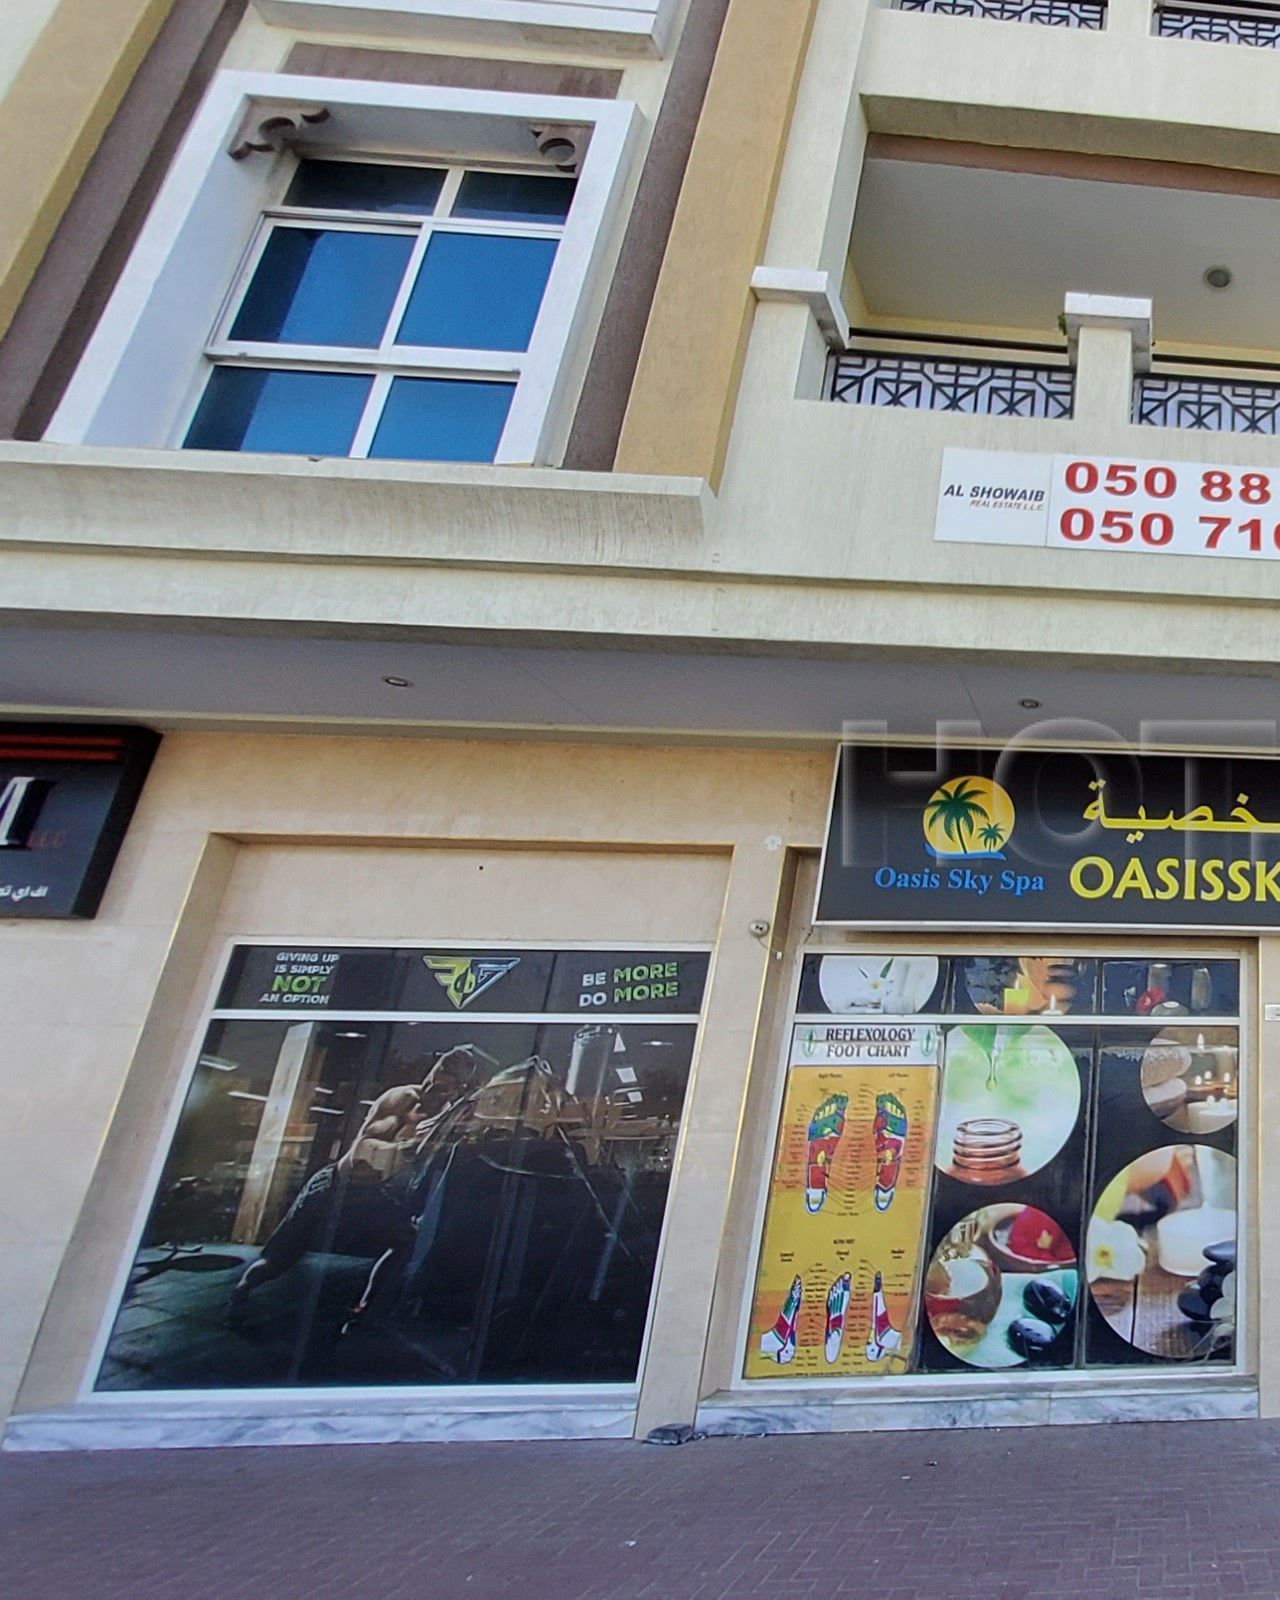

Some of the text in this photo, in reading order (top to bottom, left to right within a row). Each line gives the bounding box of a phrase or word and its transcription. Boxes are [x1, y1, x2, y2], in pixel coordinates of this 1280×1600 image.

[1064, 460, 1178, 499] 050
[943, 484, 1045, 502] AL SHOWAIB
[970, 500, 990, 508] REAL
[993, 501, 1021, 510] ESTATE
[1059, 507, 1174, 546] 050
[875, 867, 1044, 896] Oasis Sky Spa
[276, 952, 340, 963] GIVING UP
[274, 964, 335, 975] IS SIMPLY
[582, 962, 678, 987] BE MORE
[271, 975, 327, 993] NOT
[260, 993, 330, 1005] AN OPTION
[579, 981, 679, 1007] DO MORE
[825, 1028, 916, 1041] REFLEXOLOGY
[826, 1044, 911, 1058] FOOT CHART
